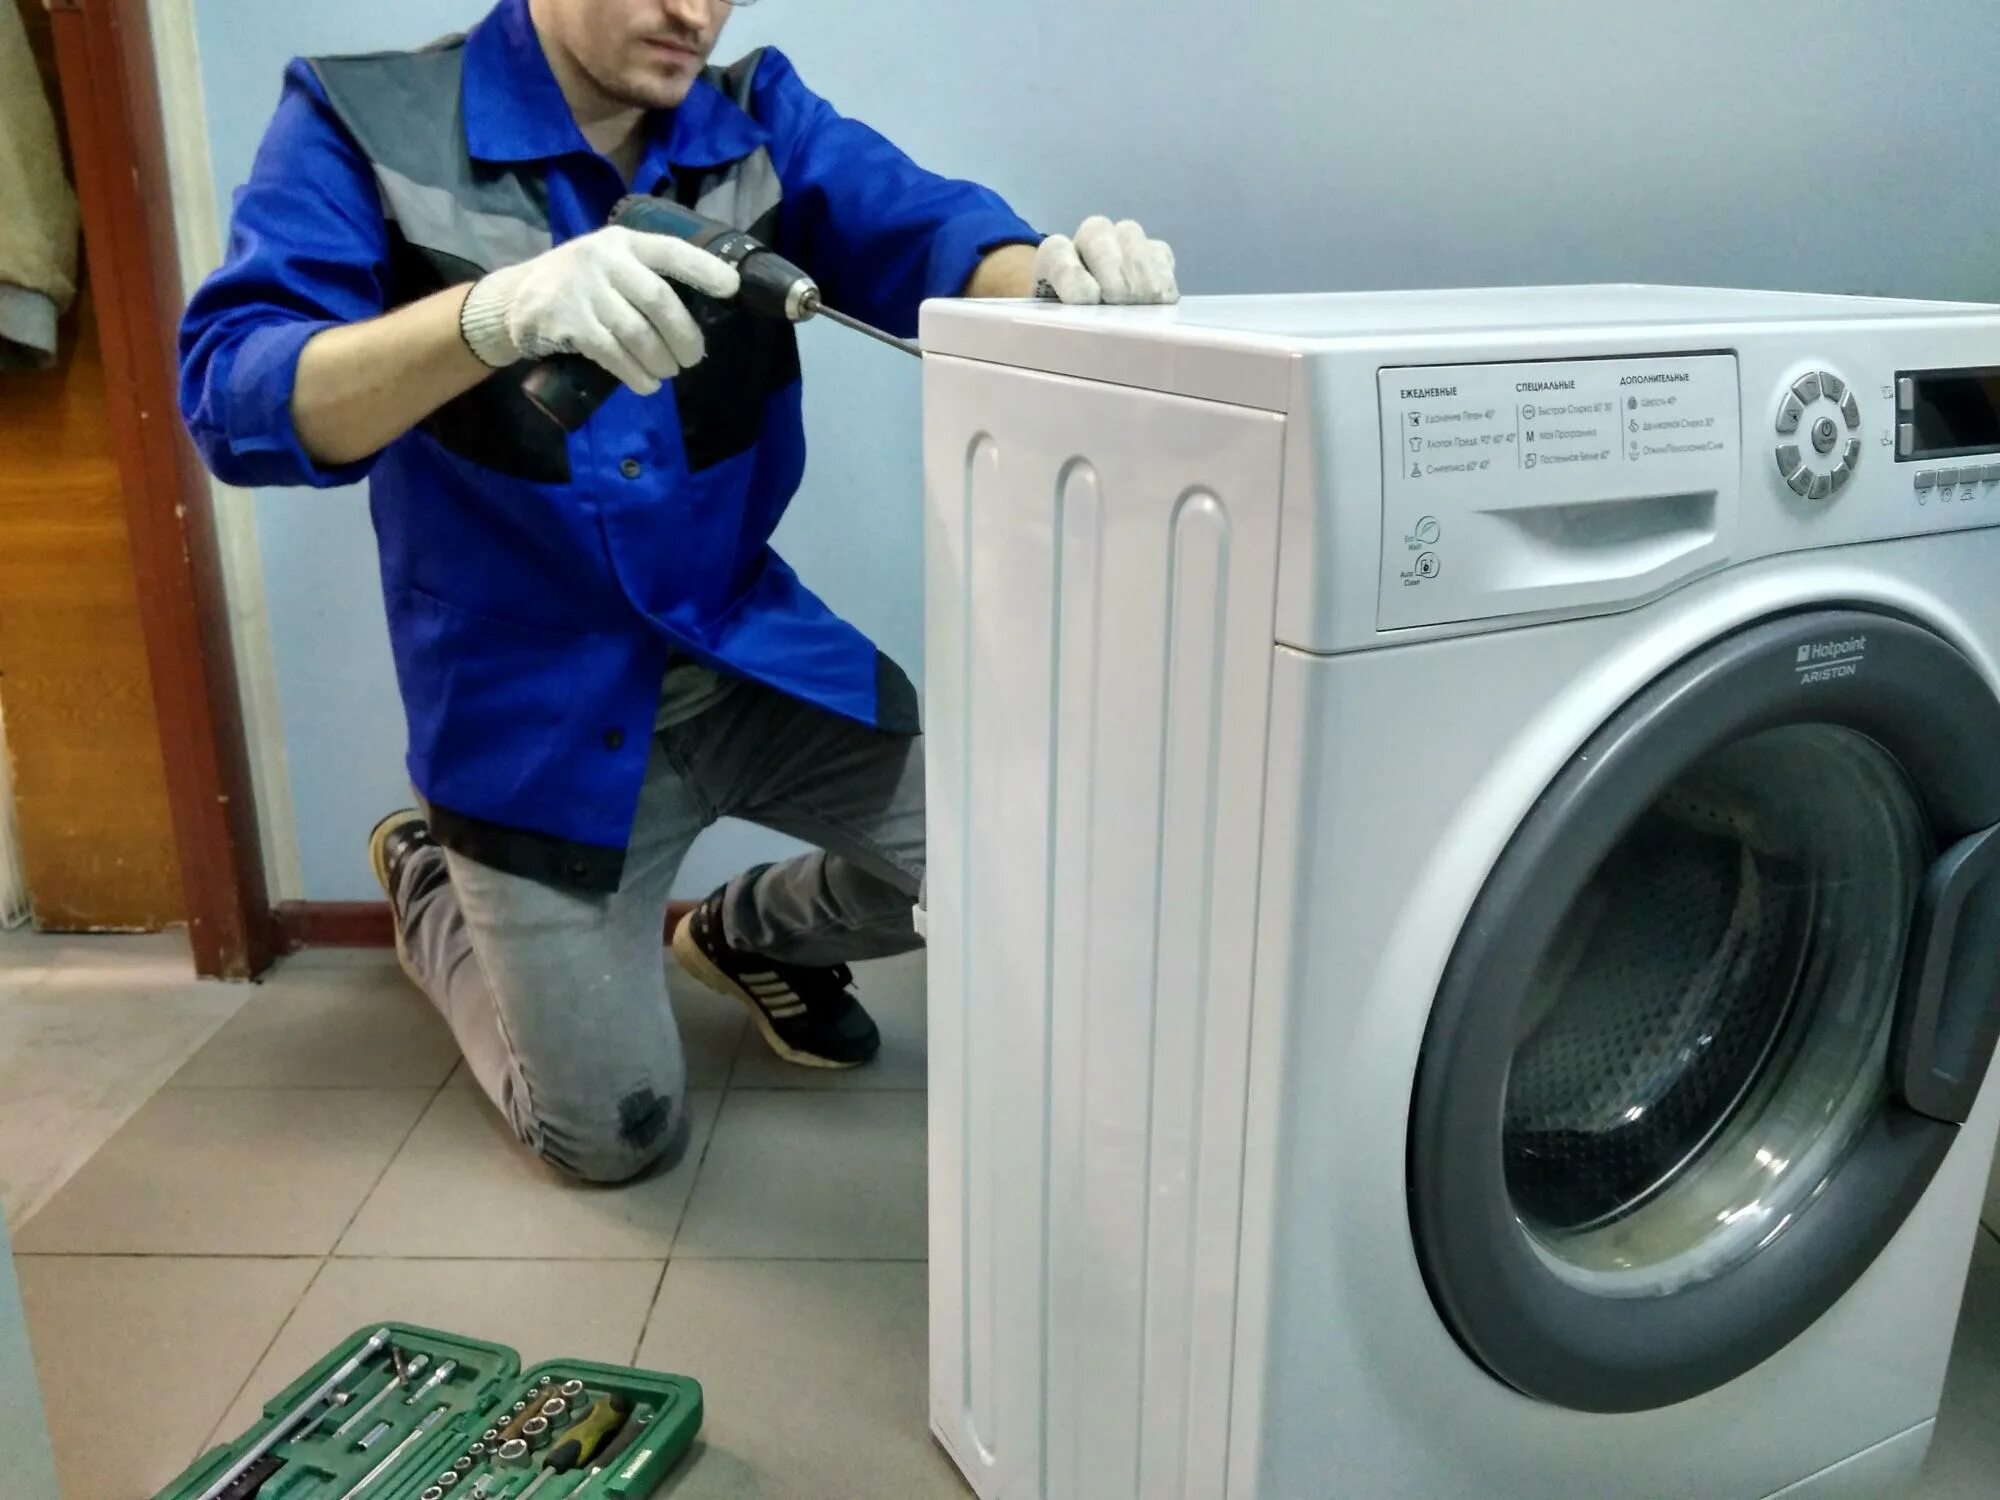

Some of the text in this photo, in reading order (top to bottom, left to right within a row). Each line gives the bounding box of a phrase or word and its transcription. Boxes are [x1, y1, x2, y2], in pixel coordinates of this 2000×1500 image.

[1620, 374, 1690, 385] ДОПОЛНИТЕЛЬНЫЕ
[1516, 380, 1576, 392] СПЕЦИАЛЬНЫЕ
[1400, 387, 1457, 399] ЕЖЕДНЕВНЫЕ
[1811, 636, 1866, 658] Hotpoint
[1800, 664, 1856, 685] ARISTON
